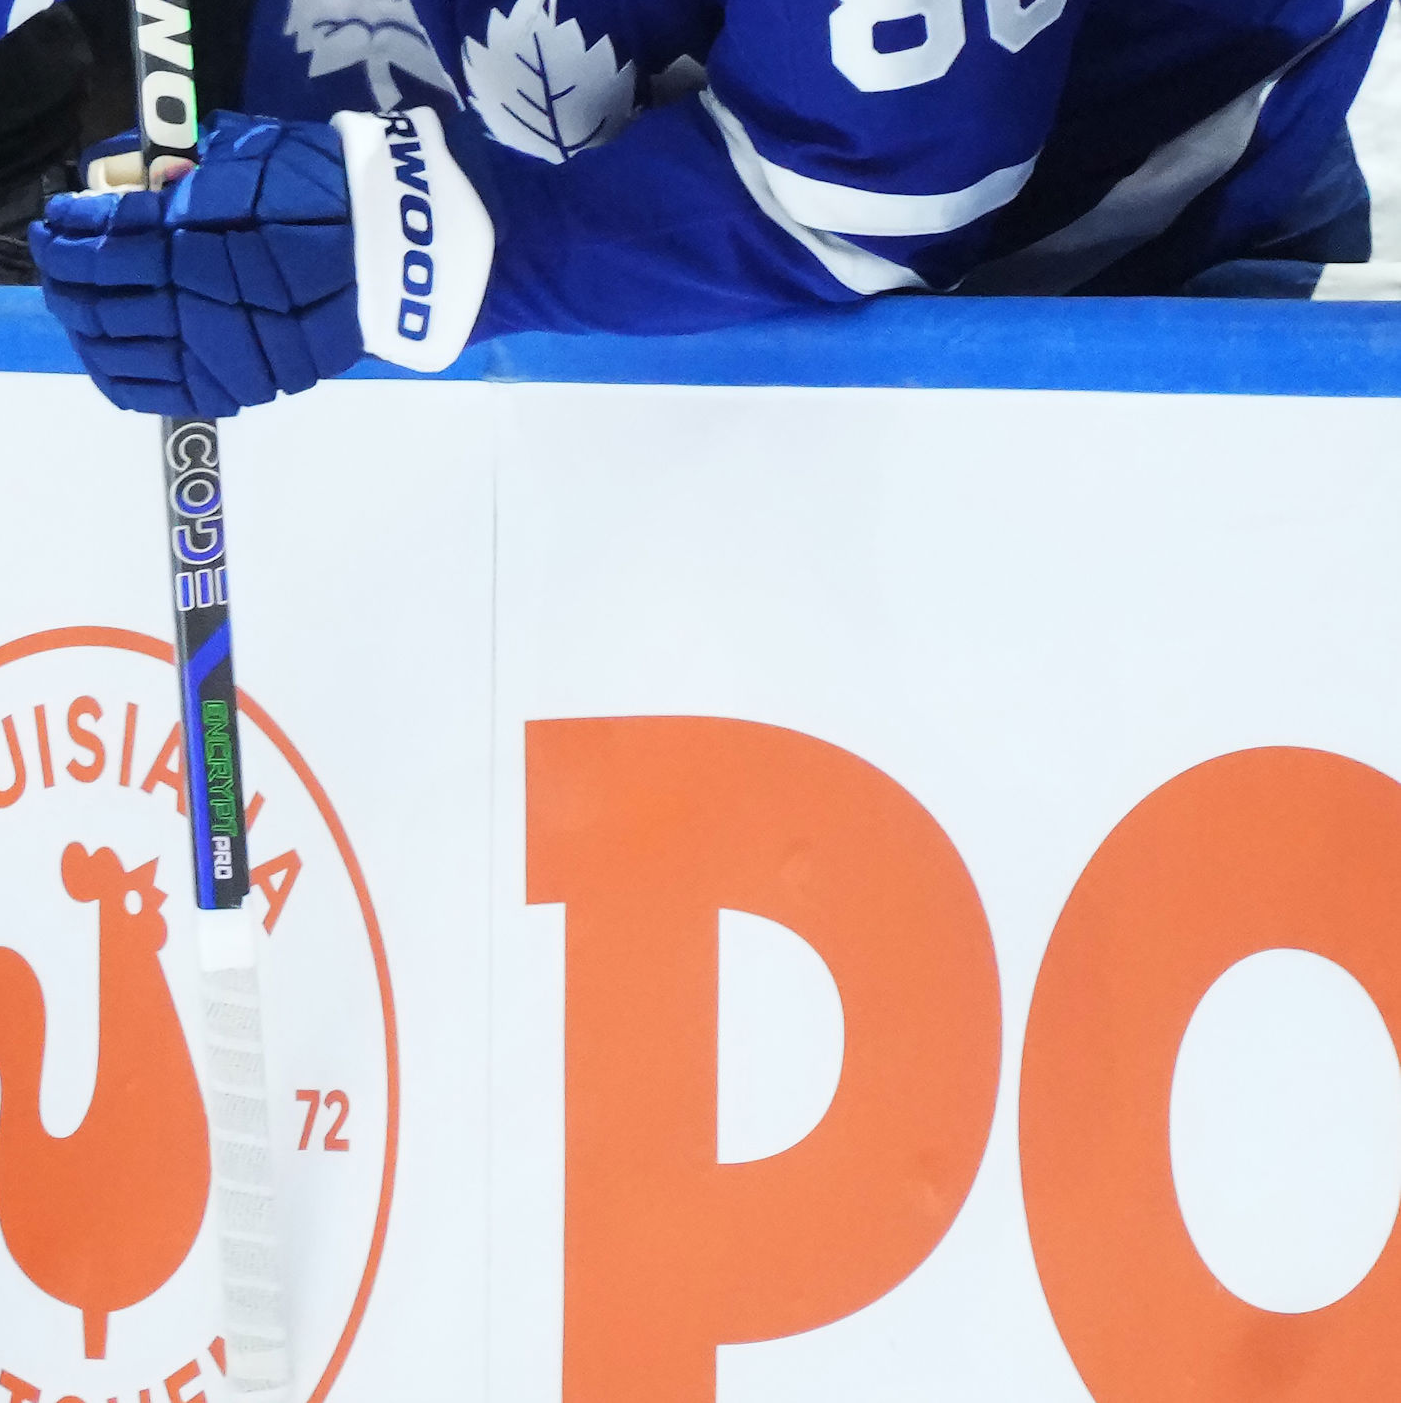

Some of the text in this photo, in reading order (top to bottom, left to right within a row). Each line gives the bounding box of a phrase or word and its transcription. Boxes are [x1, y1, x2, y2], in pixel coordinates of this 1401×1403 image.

[212, 836, 233, 881] PRO
[525, 715, 1401, 1403] PO
[294, 1089, 351, 1152] 72
